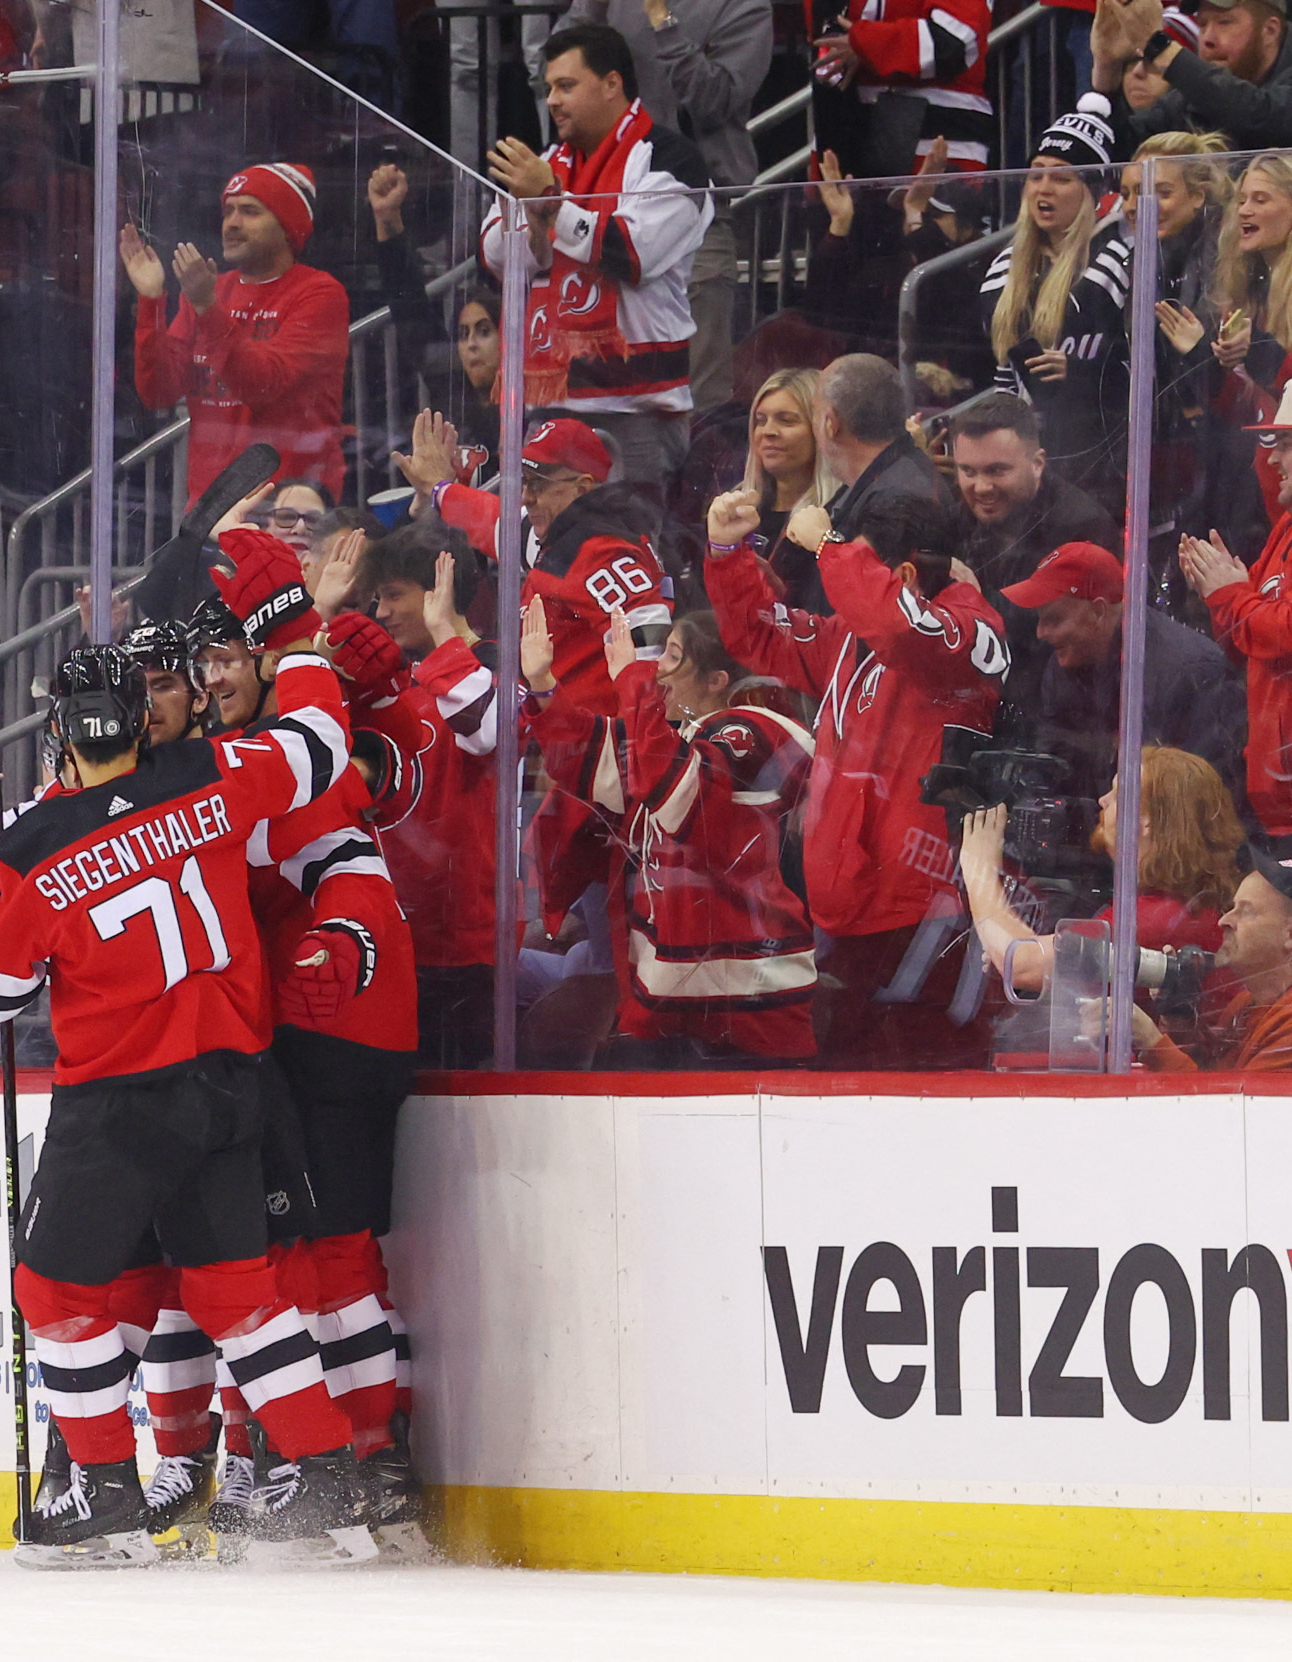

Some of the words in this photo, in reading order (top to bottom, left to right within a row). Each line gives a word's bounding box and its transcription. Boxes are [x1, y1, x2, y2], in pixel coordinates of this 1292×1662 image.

[1055, 117, 1105, 146] EVILS
[585, 555, 654, 614] 86
[83, 717, 103, 738] 71
[107, 801, 135, 817] adidas
[35, 793, 233, 911] SIEGENTHALER
[87, 854, 232, 995] 71
[761, 1185, 1291, 1425] verizon
